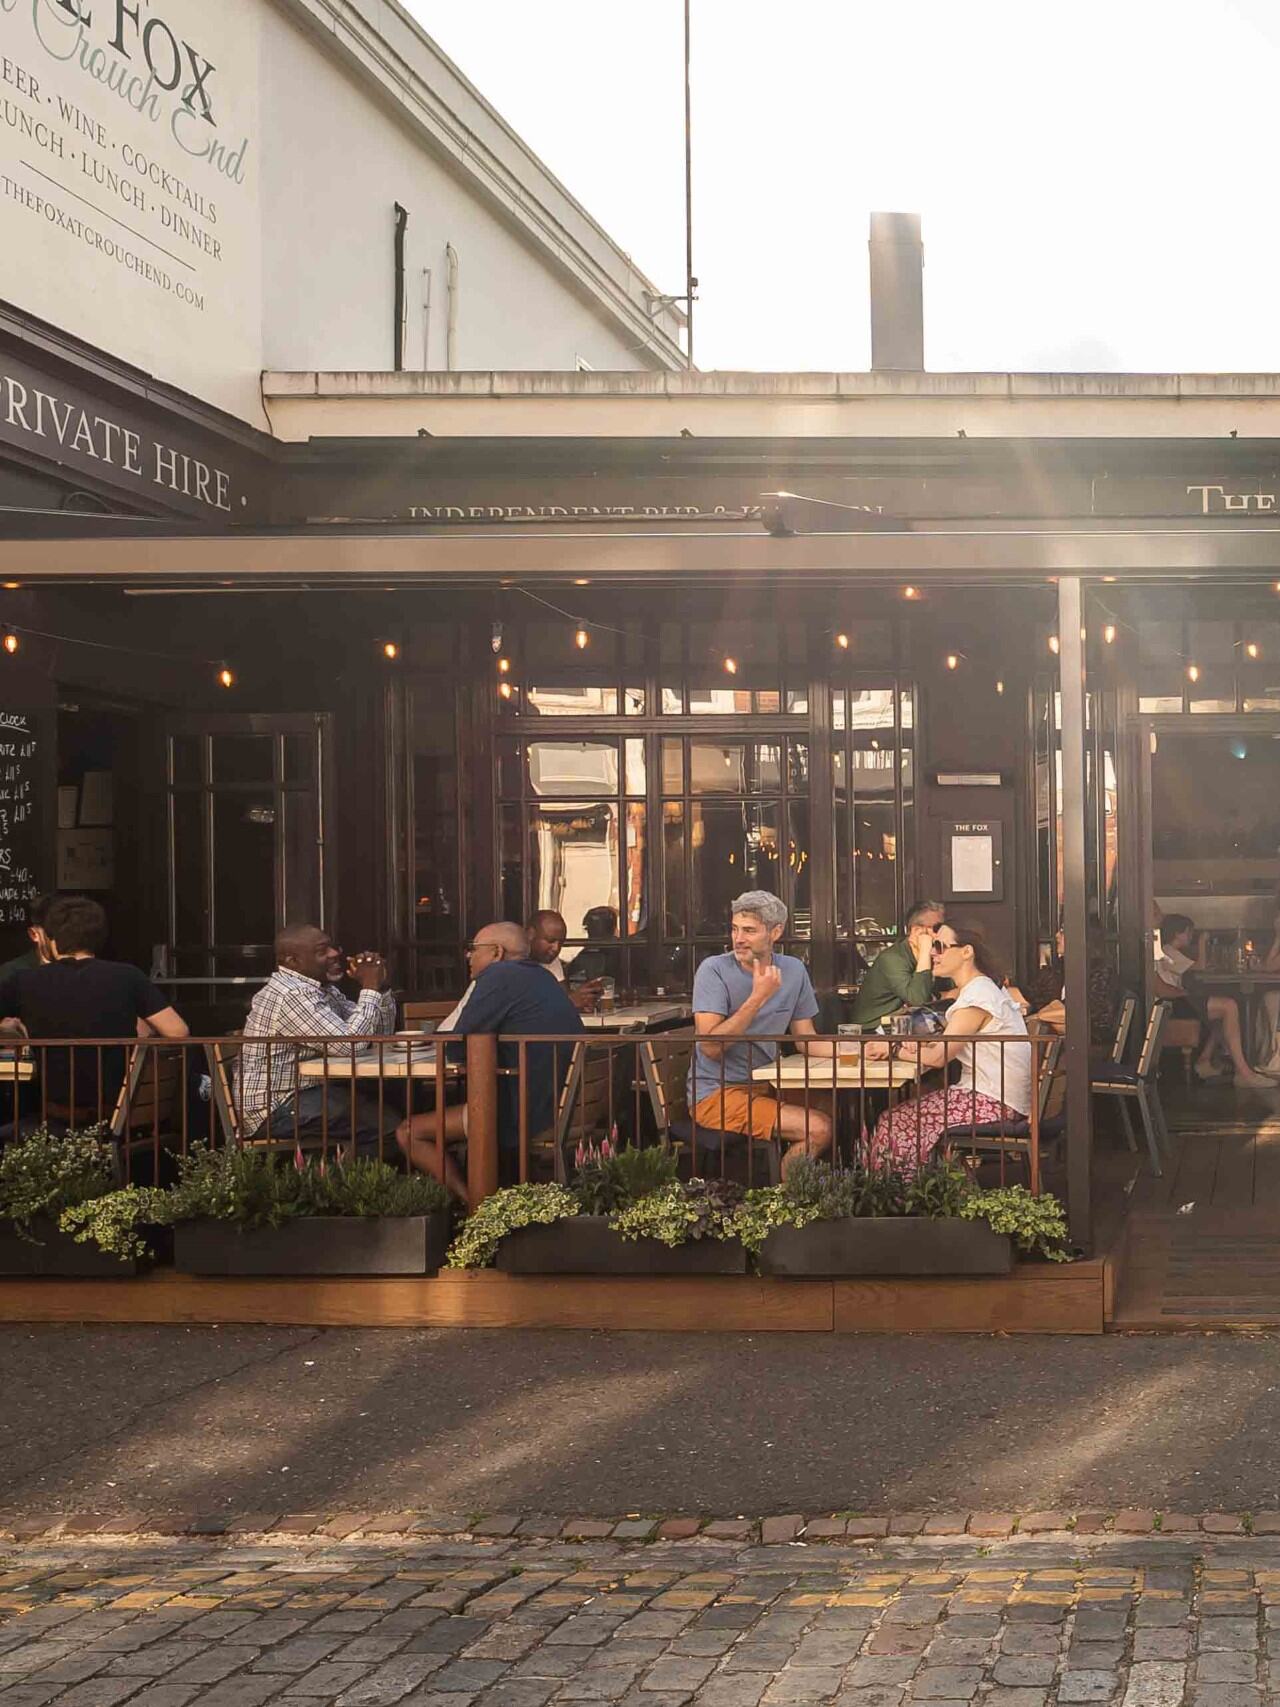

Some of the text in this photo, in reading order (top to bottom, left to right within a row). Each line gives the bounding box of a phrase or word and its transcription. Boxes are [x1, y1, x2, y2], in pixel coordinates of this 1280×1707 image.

[33, 0, 249, 184] Crouch End
[107, 0, 217, 127] FOX
[0, 98, 222, 261] UNCH LUNCH DINNER
[56, 95, 107, 149] WINE
[121, 143, 217, 224] COCKTAILS
[0, 376, 231, 512] RIVATE HIRE
[953, 824, 989, 832] THE FOX
